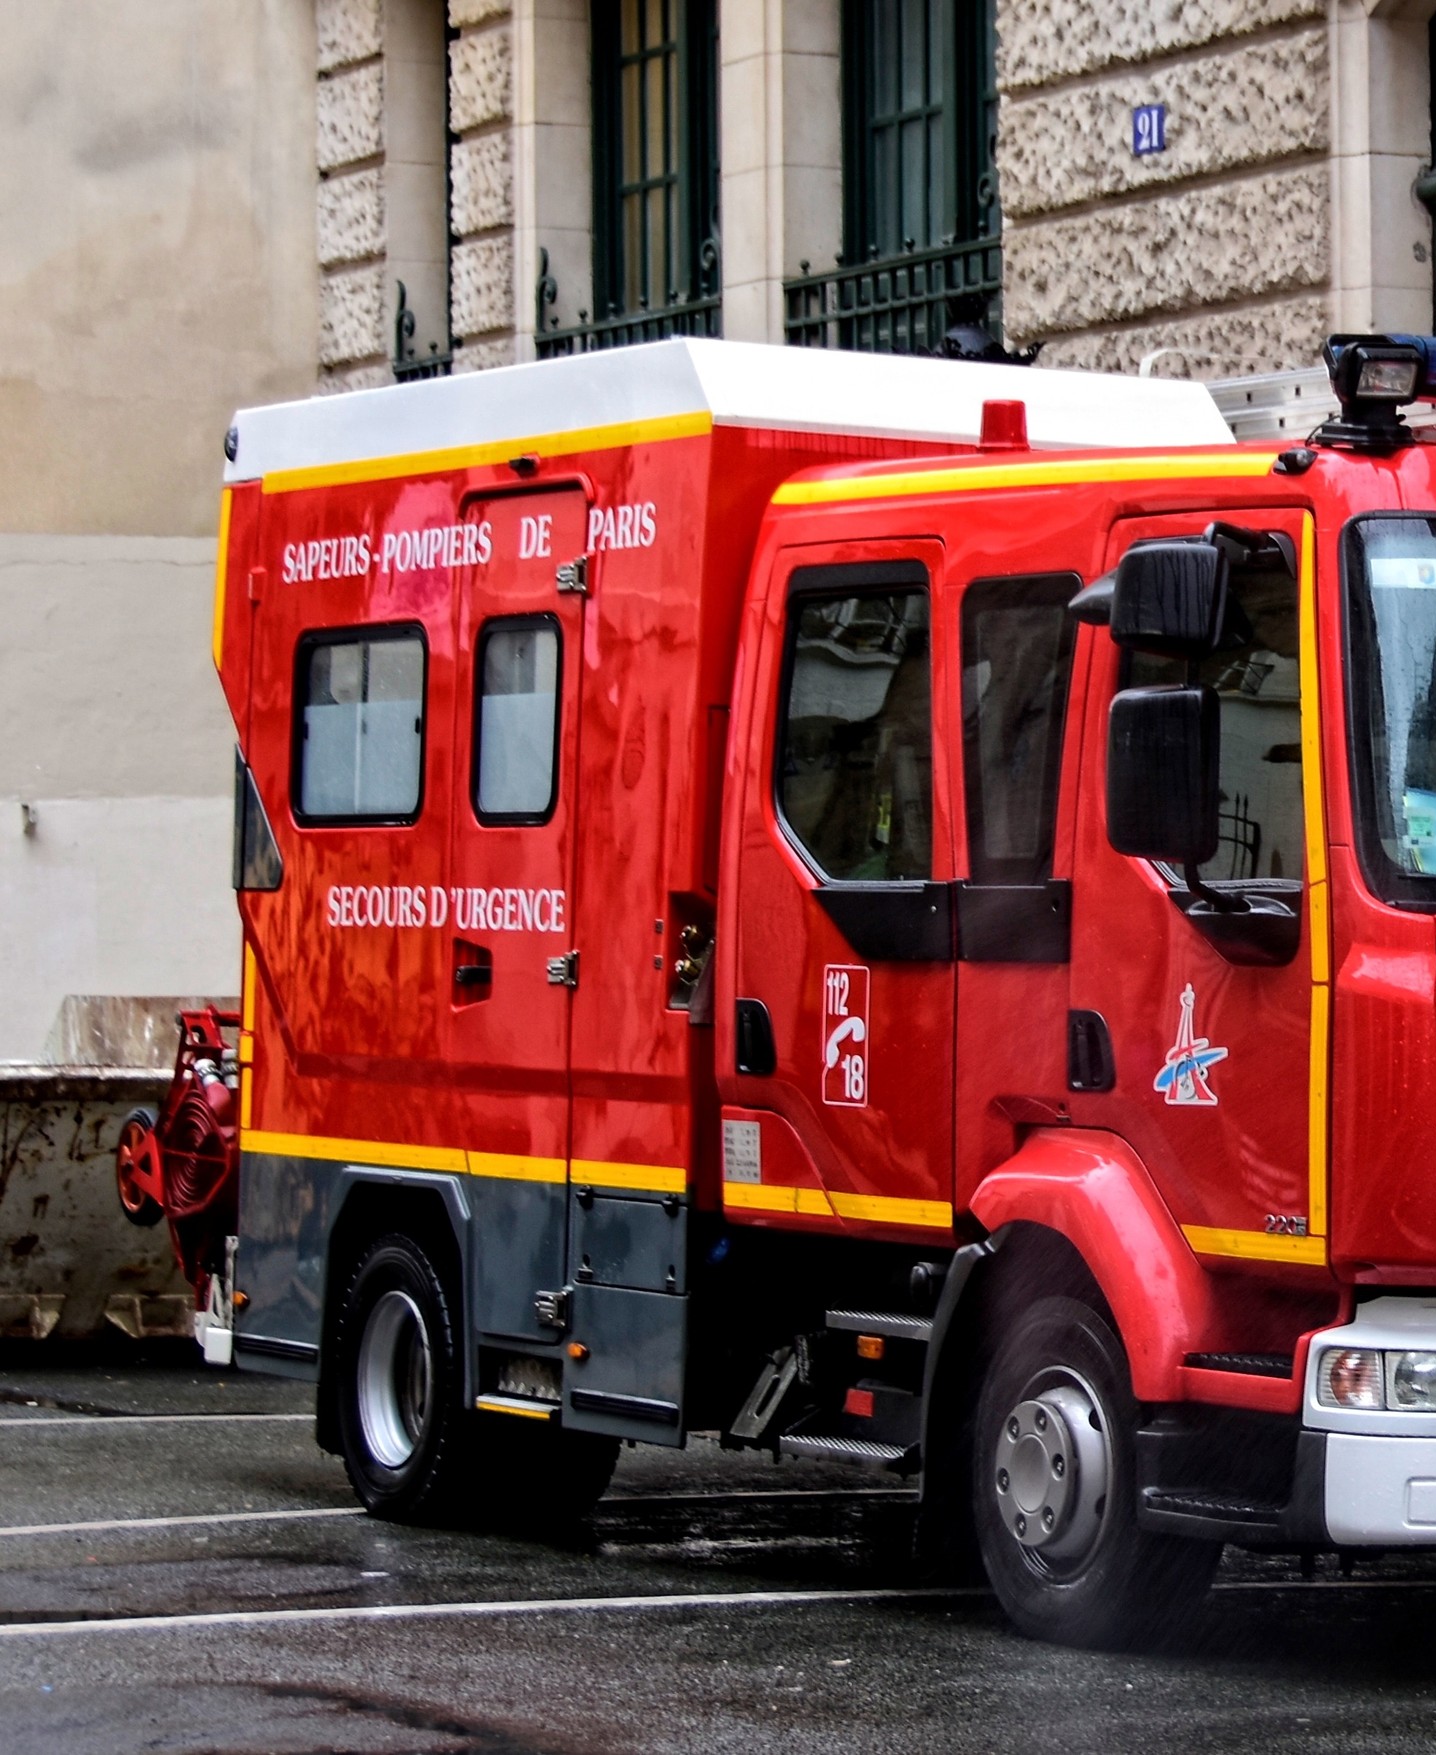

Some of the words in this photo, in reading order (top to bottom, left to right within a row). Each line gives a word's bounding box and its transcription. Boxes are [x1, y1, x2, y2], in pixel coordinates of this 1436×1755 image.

[282, 522, 492, 584] SAPEURS-POMPIERS
[519, 515, 552, 560] DE
[587, 501, 657, 551] PARIS
[327, 885, 426, 928] SECOURS
[827, 970, 849, 1016] 112
[841, 1054, 865, 1100] 18
